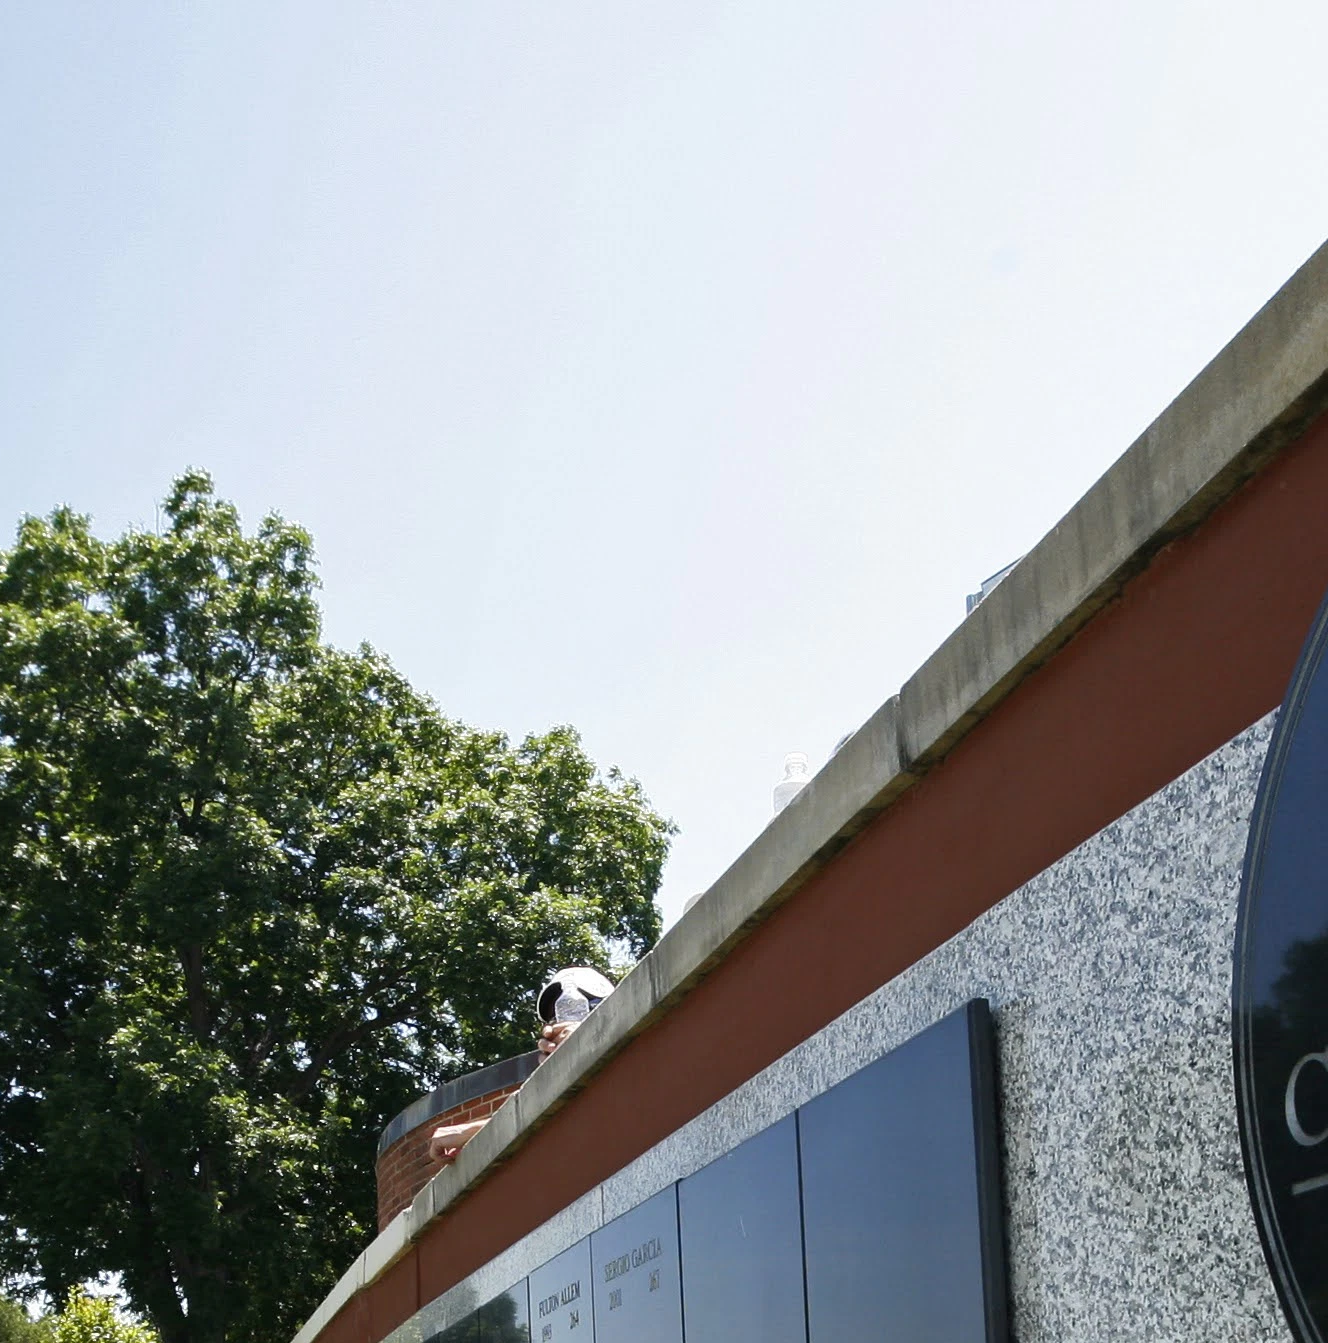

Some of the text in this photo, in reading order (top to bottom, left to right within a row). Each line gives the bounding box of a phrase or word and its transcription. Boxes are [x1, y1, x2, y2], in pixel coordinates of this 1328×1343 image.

[604, 1237, 662, 1283] SERGIO GARCIA
[538, 1280, 581, 1319] FULTON ALLEM
